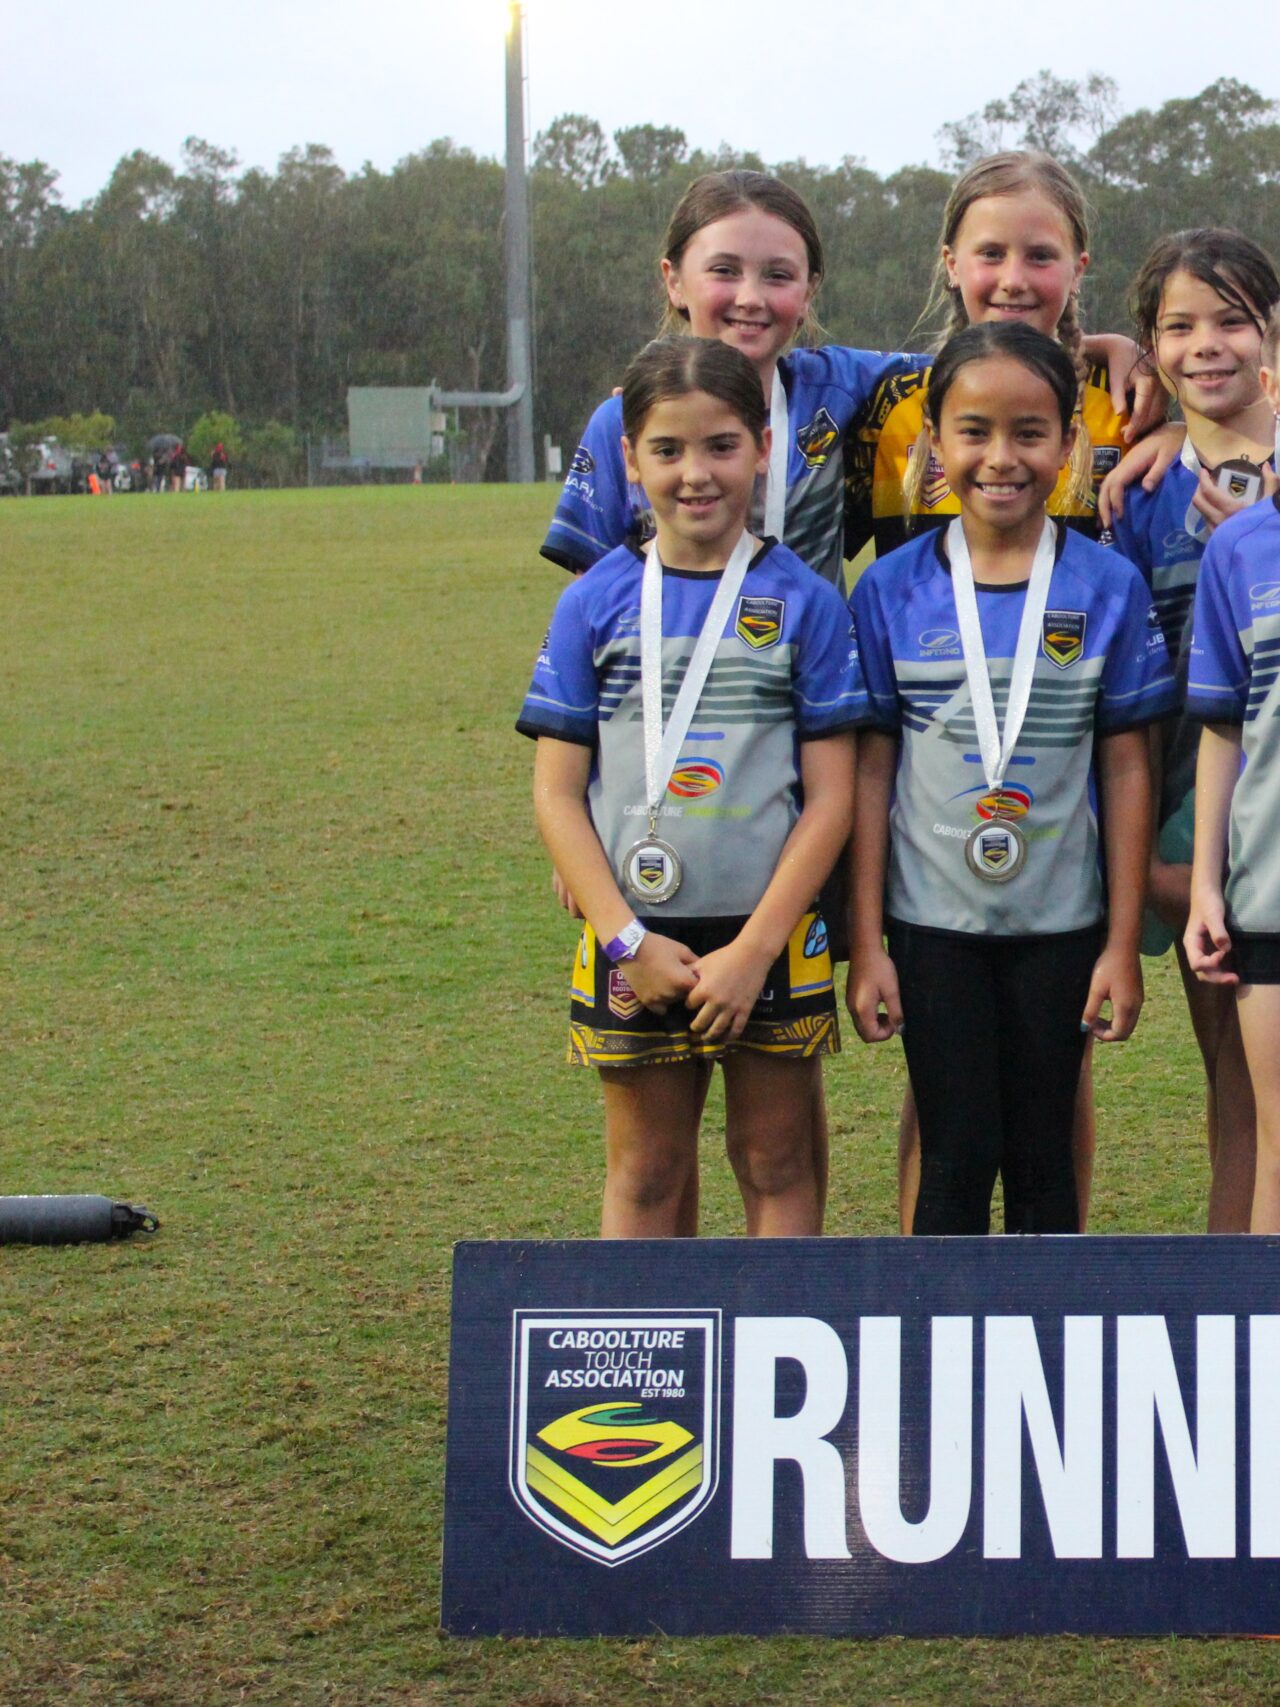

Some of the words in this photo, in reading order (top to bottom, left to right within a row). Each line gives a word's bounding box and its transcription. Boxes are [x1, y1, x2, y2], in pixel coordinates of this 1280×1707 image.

[549, 1330, 686, 1349] CABOOLTURE
[584, 1351, 653, 1370] TOUCH
[544, 1369, 685, 1388] ASSOCIATION
[640, 1388, 661, 1398] EST
[661, 1388, 686, 1398] 1980
